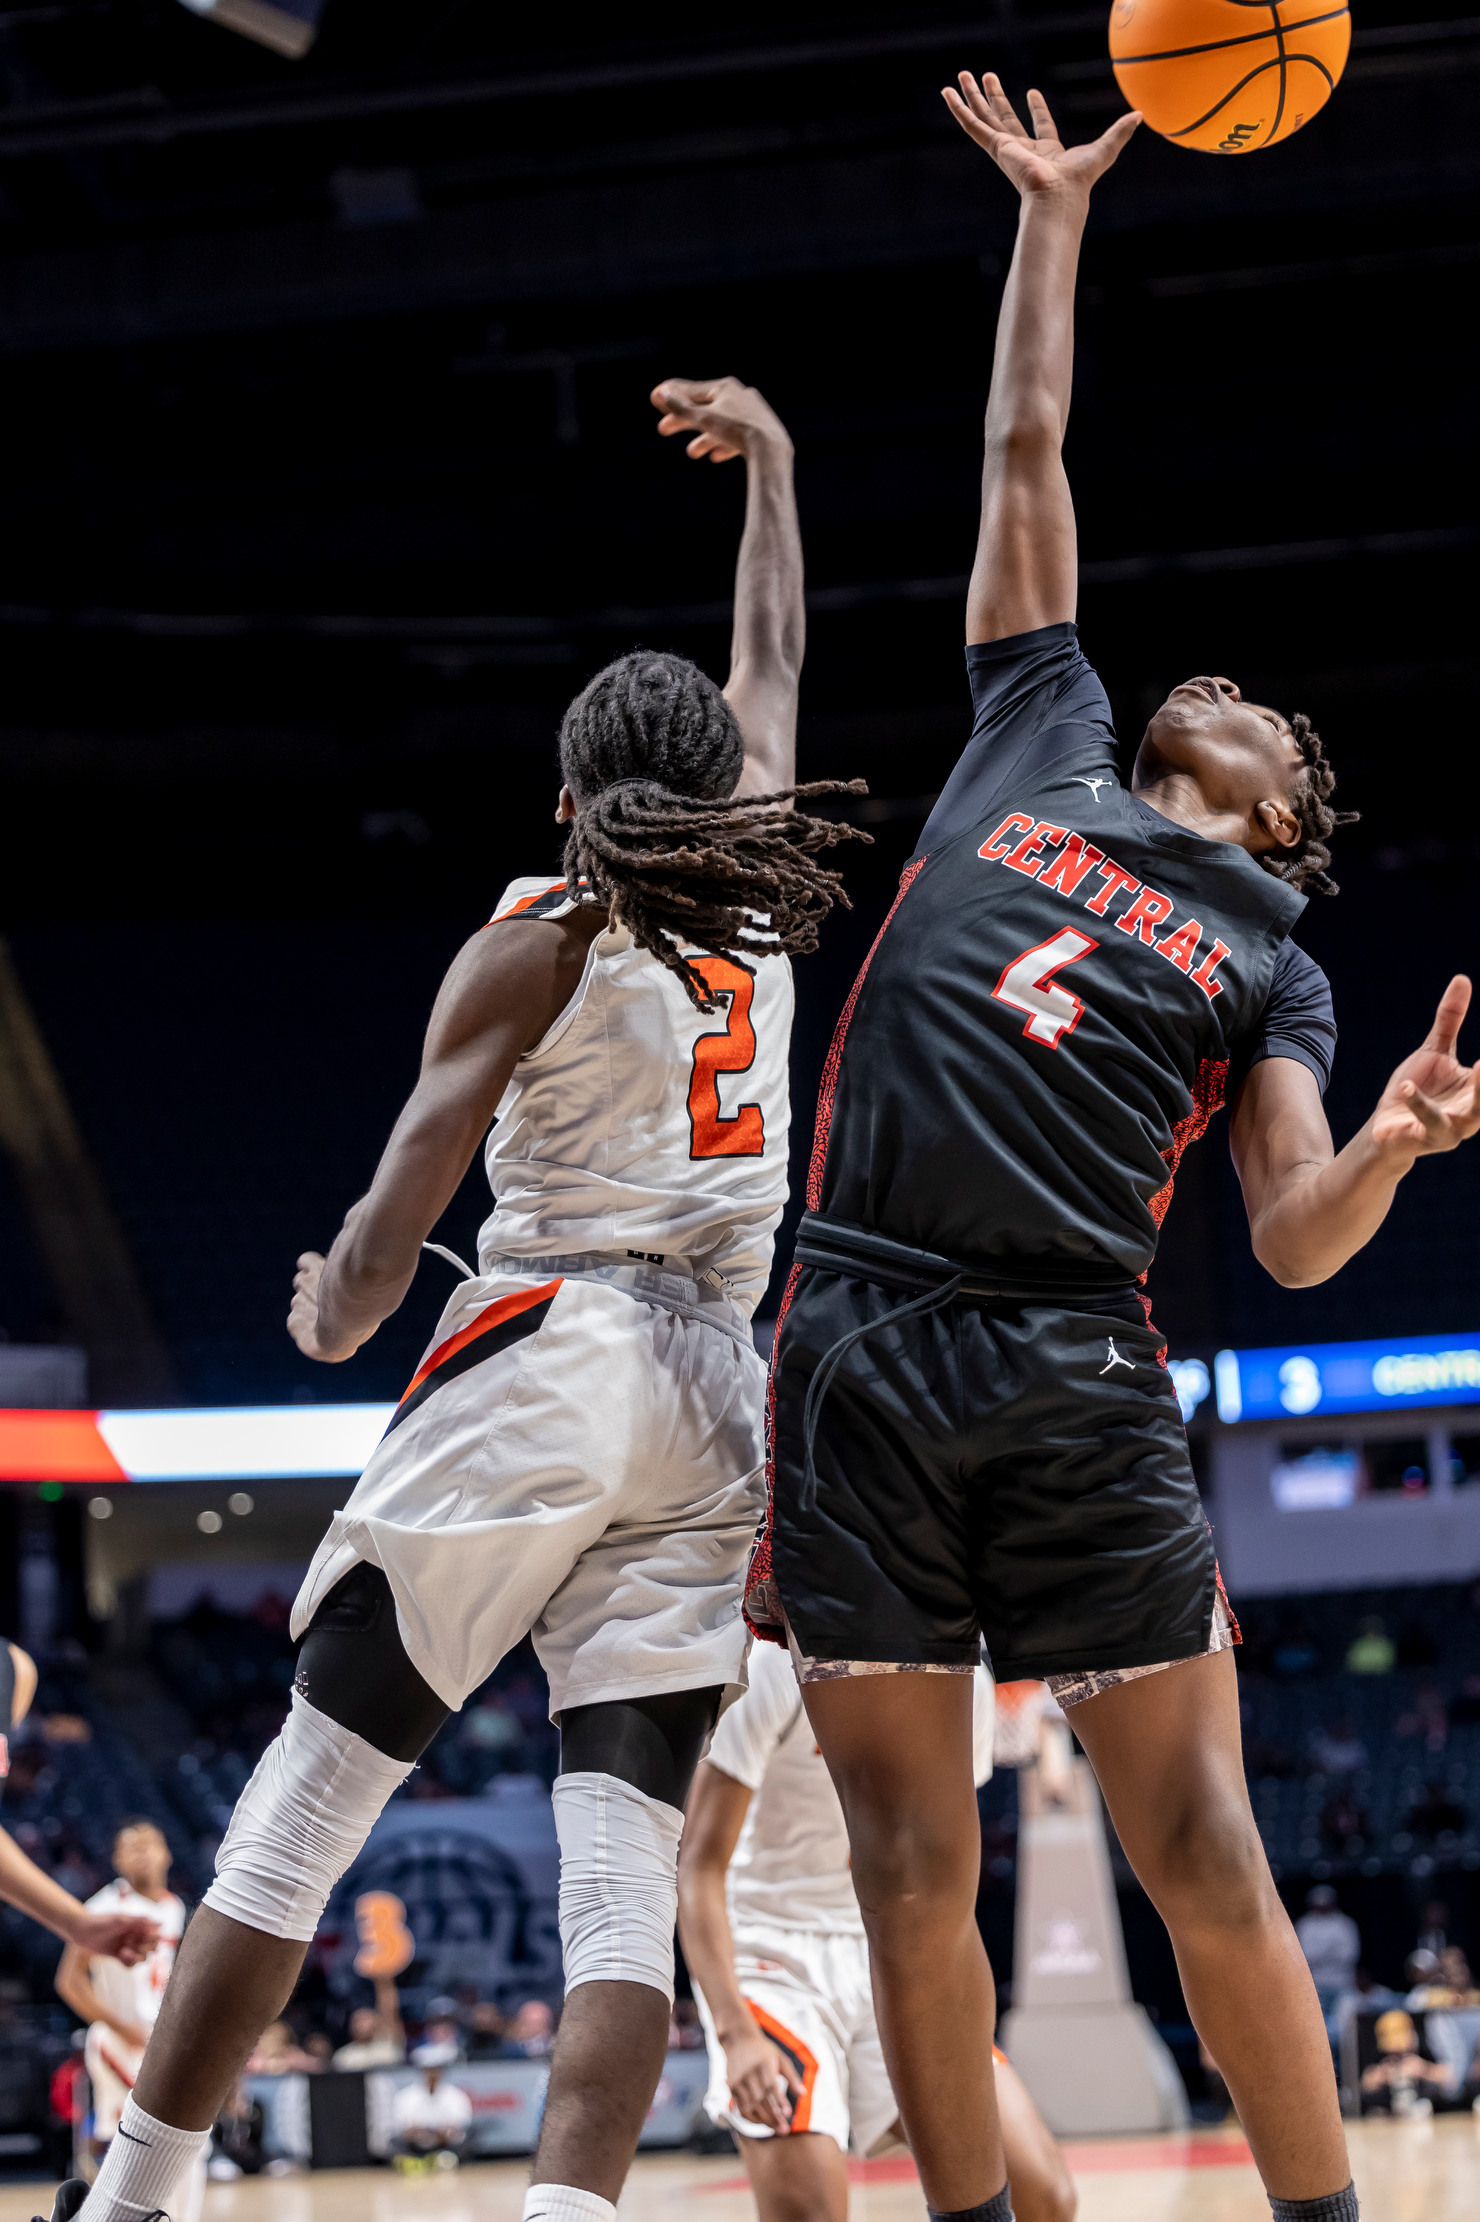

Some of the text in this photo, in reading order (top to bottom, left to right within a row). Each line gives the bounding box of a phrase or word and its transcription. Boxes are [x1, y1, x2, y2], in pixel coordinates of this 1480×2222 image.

[977, 812, 1232, 1001] CENTRAL
[990, 925, 1100, 1050] 4
[686, 953, 765, 1161] 2
